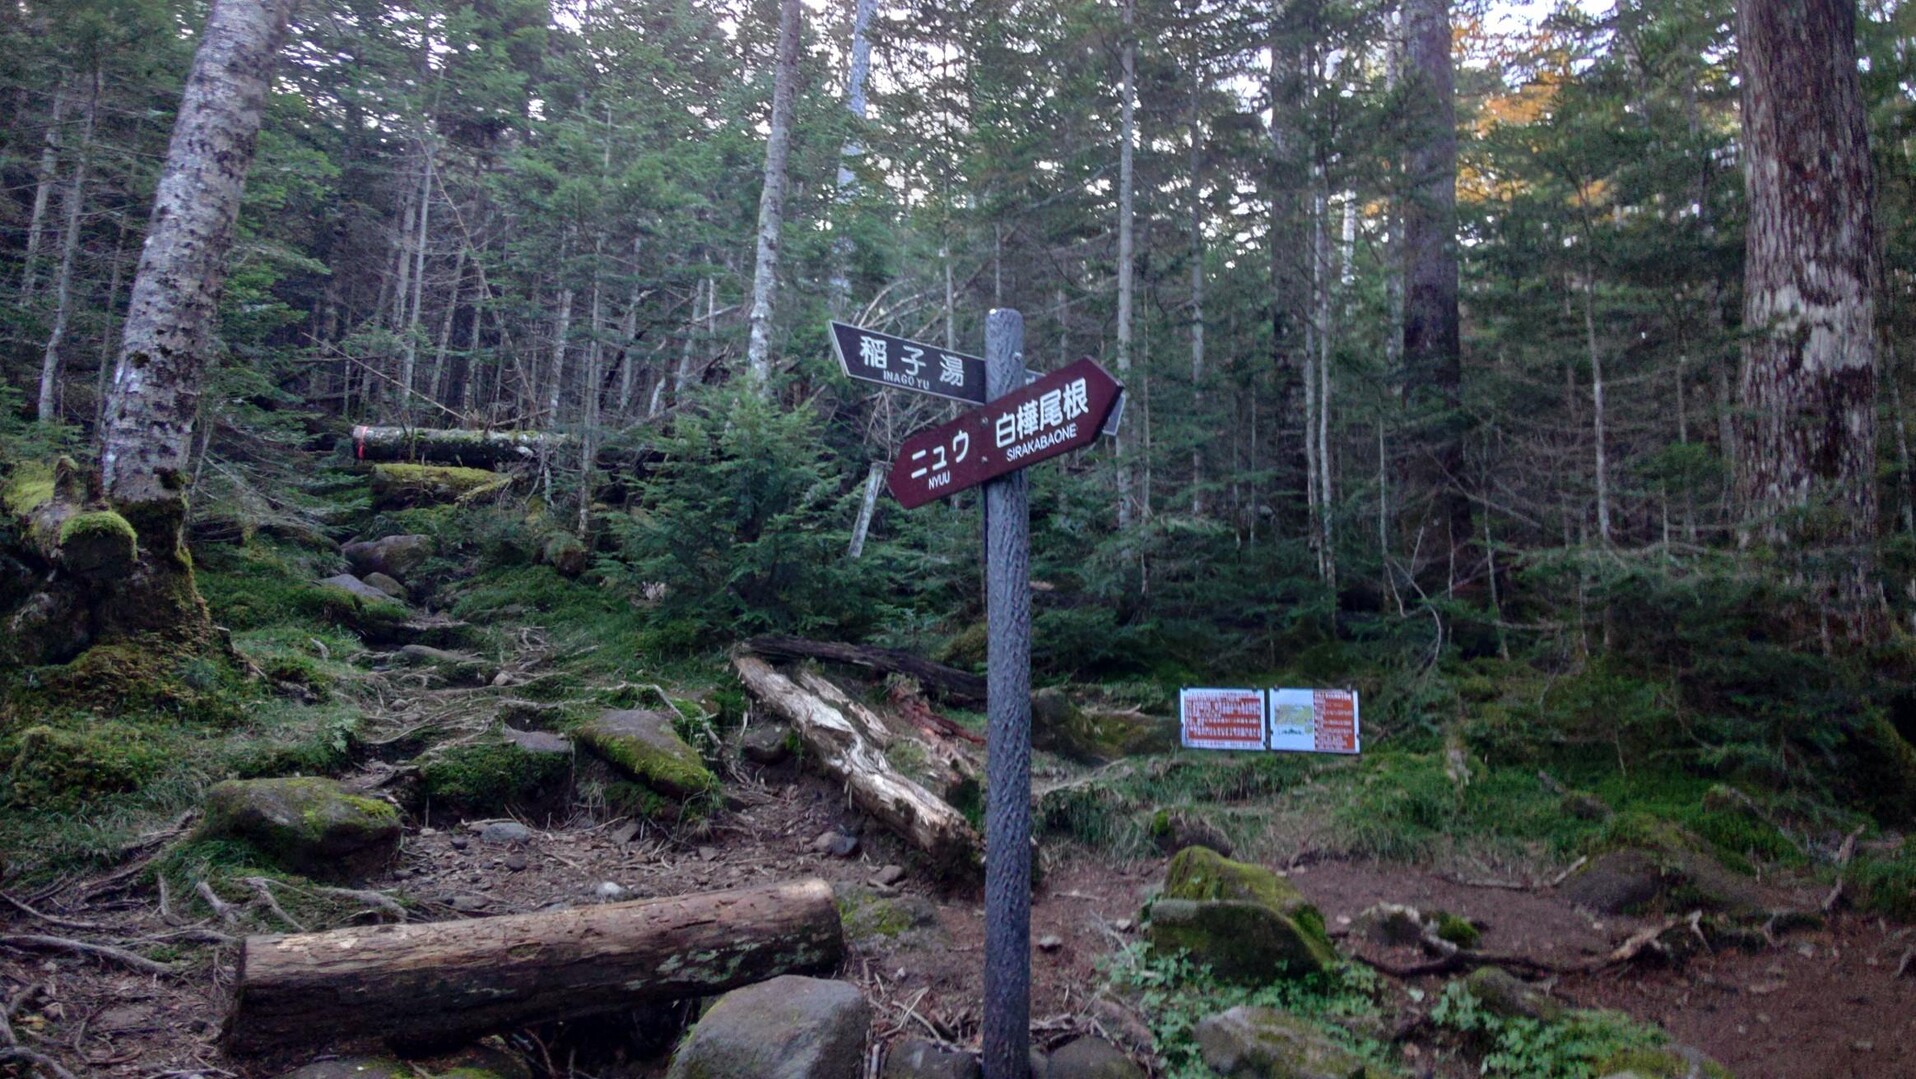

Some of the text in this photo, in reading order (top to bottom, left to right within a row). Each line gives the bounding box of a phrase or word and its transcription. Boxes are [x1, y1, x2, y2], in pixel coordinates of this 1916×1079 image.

[860, 335, 965, 387] 稲子湯
[995, 377, 1090, 449] 白樺尾根
[911, 429, 969, 479] ニュウ
[1006, 422, 1078, 462] SIRAKABAONE
[928, 470, 951, 490] NYUU
